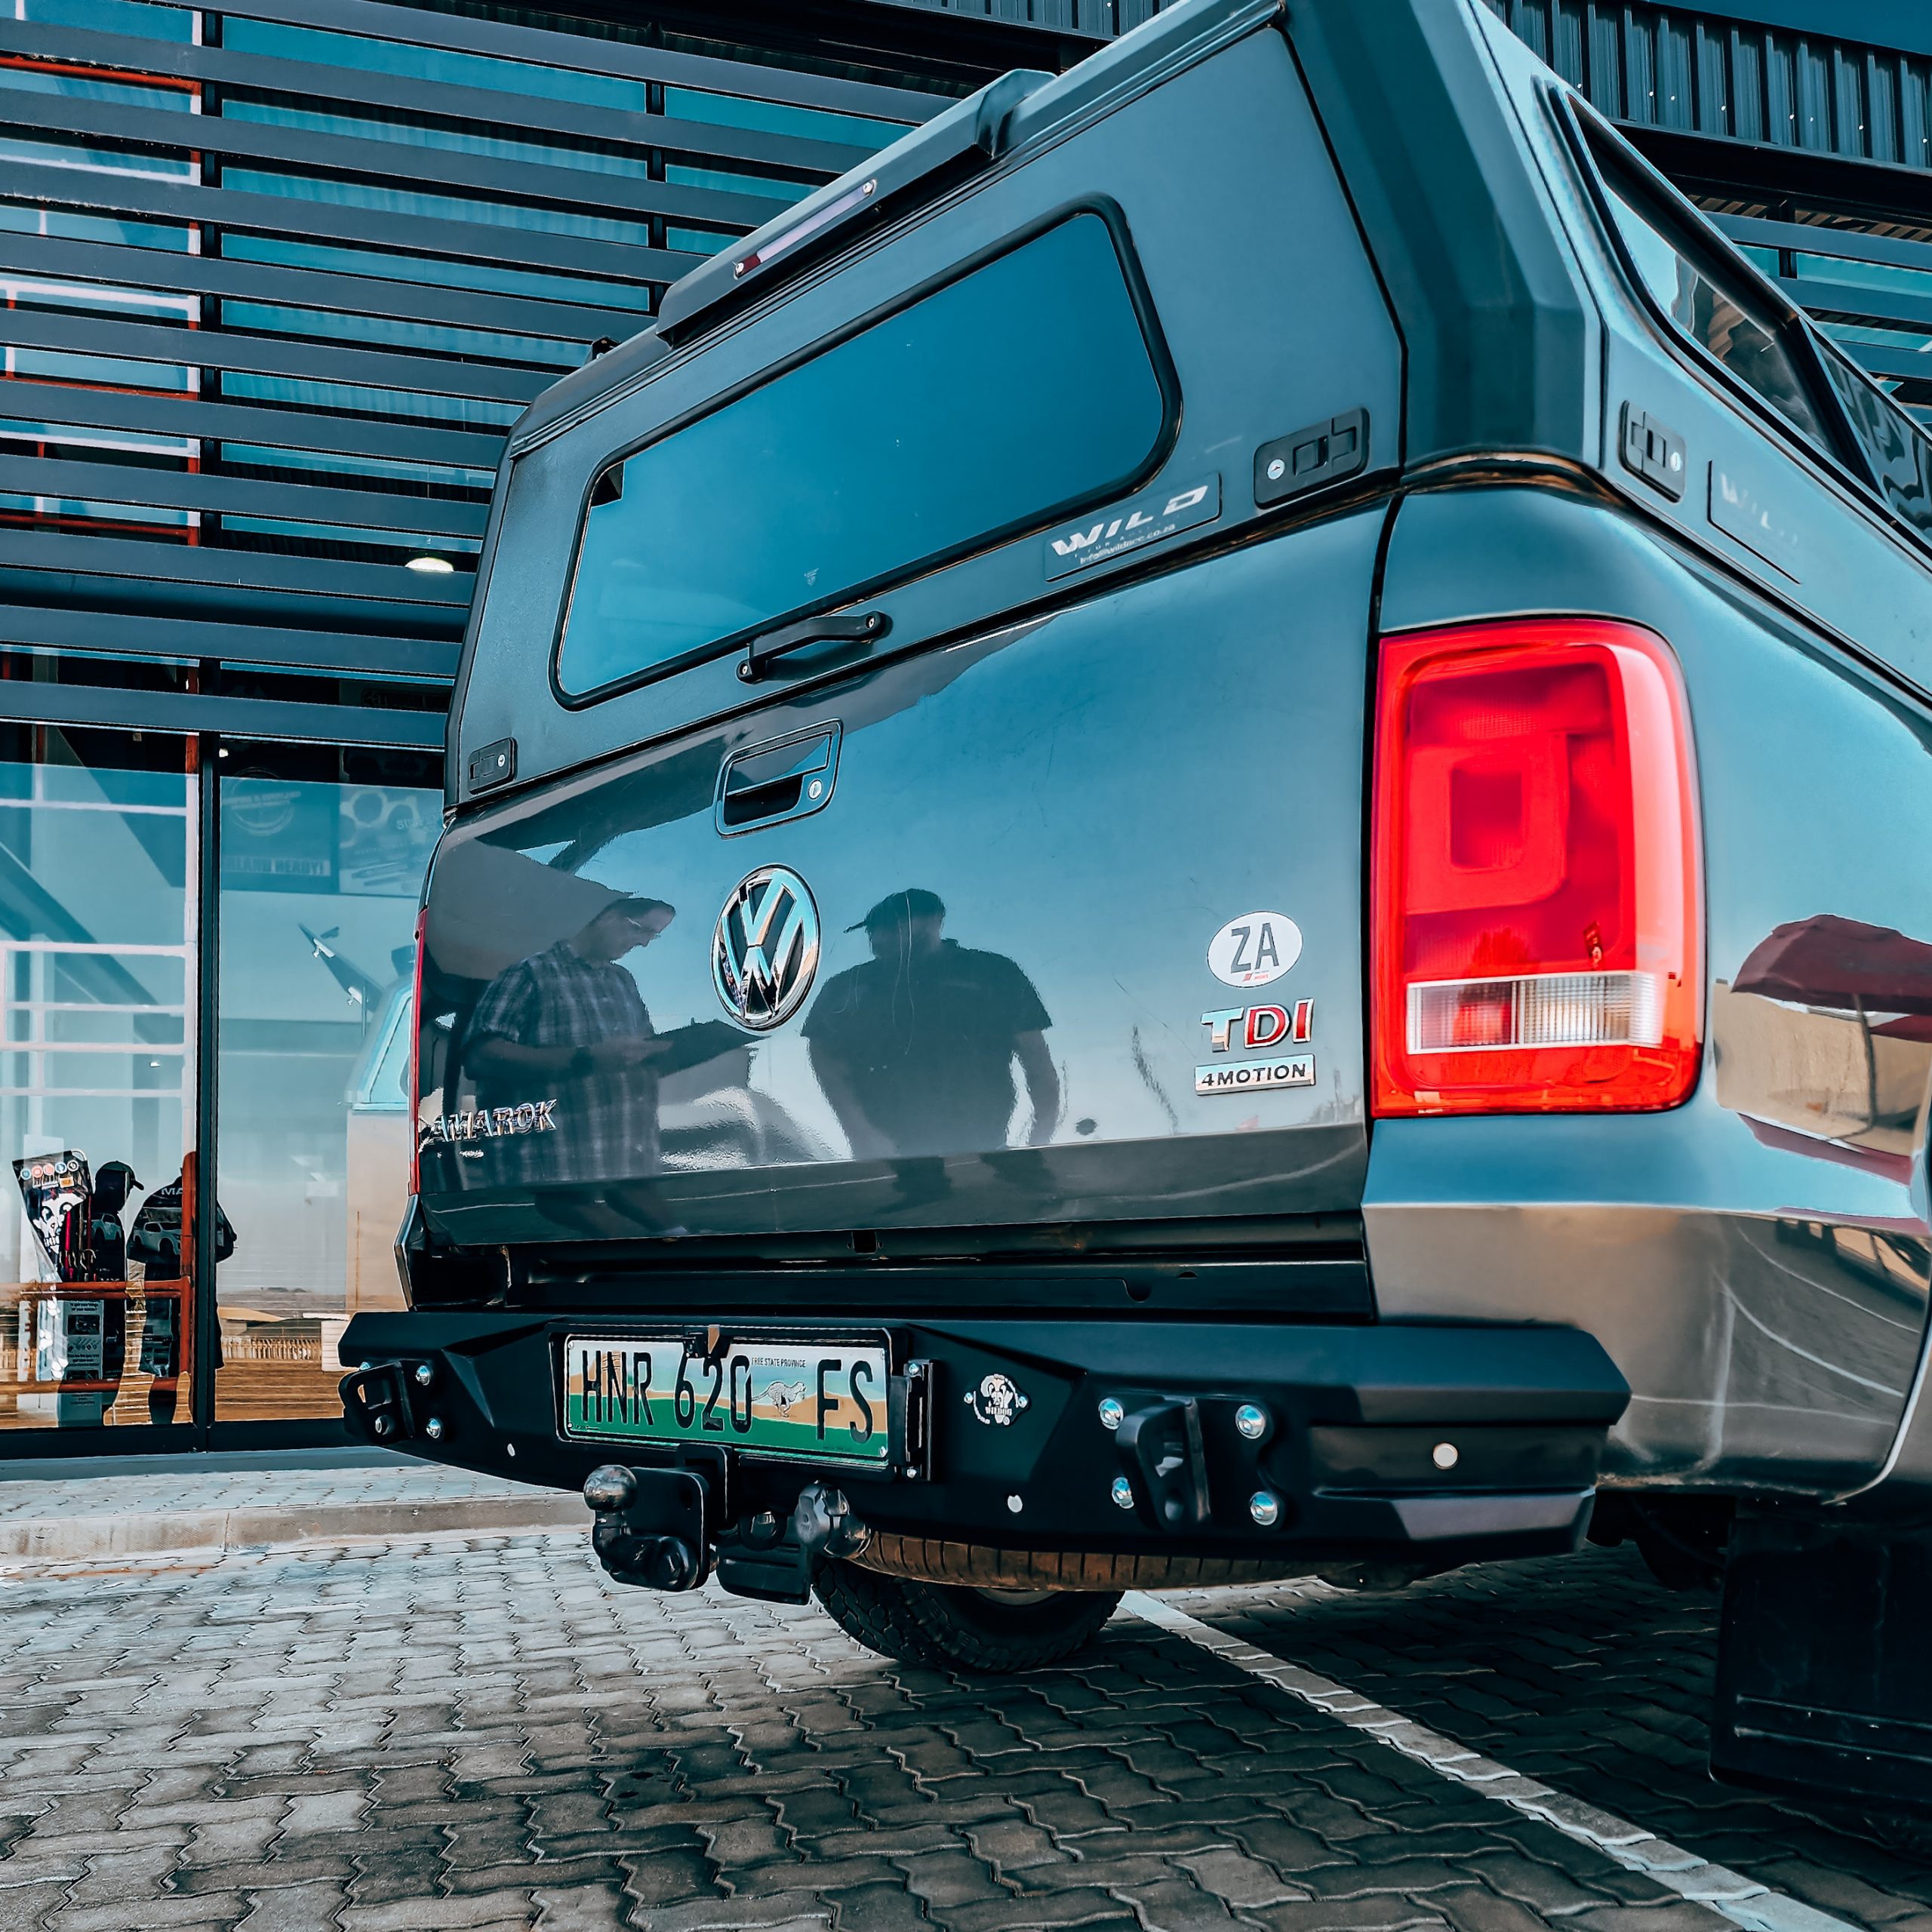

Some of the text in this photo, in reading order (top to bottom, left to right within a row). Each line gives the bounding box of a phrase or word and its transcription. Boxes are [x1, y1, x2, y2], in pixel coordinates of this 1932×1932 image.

[1051, 485, 1208, 555] WILD
[1230, 922, 1280, 974] ZA
[1201, 998, 1315, 1052] TDI
[1201, 1063, 1306, 1087] 4MOTION
[430, 1098, 557, 1143] AMAROK
[752, 1357, 806, 1368] FREE STATE PROVINCE
[582, 1350, 874, 1443] HNR 620 FS
